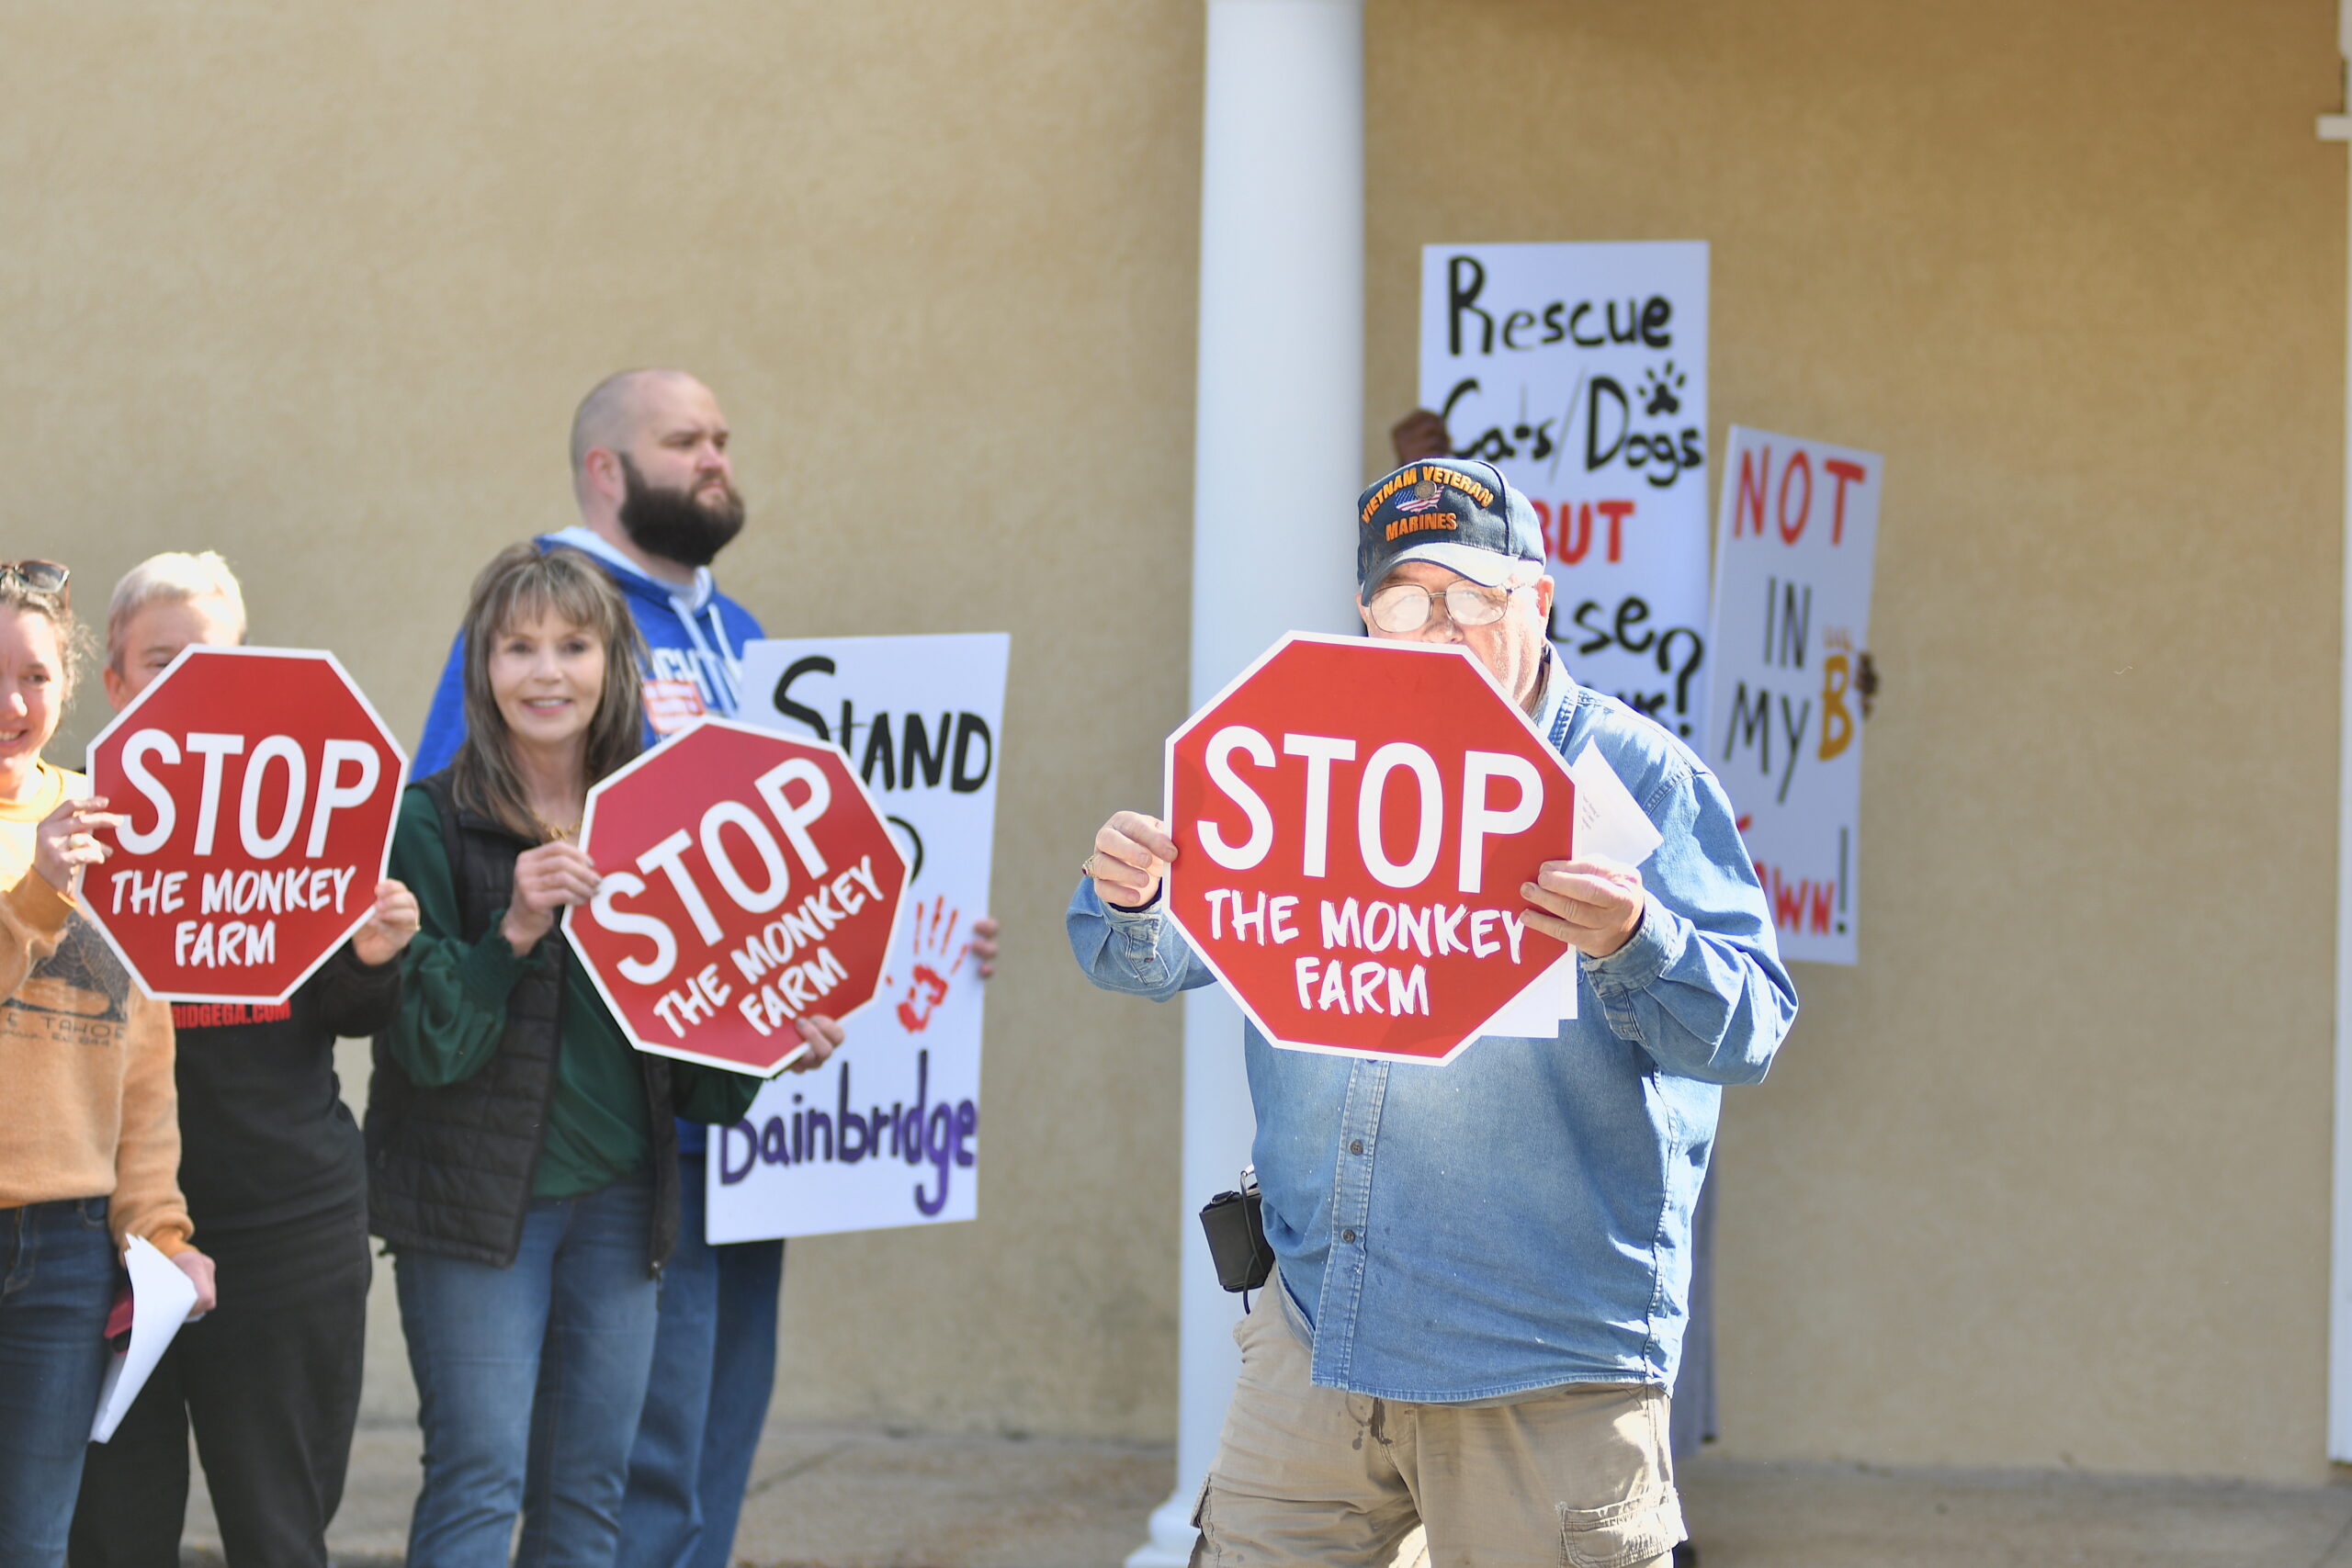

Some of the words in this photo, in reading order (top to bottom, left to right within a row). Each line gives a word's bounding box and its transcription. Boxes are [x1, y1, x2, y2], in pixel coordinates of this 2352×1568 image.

[1447, 255, 1673, 356] Rescue
[1362, 467, 1418, 525] VIETNAM
[1422, 466, 1495, 509] VETERAN
[1385, 512, 1458, 543] MARINES
[1733, 443, 1867, 547] NOT
[1764, 575, 1812, 671] IN
[1722, 676, 1810, 806] MY
[115, 728, 381, 860] STOP
[1196, 724, 1545, 895] STOP
[110, 867, 188, 917] THE
[200, 864, 357, 917] MONKEY
[590, 756, 833, 987] STOP
[174, 919, 277, 969] FARM
[652, 963, 731, 1038] THE
[729, 854, 886, 980] MONKEY
[1204, 888, 1299, 947] THE
[1319, 897, 1527, 965] MONKEY
[737, 947, 849, 1037] FARM
[1295, 955, 1430, 1017] FARM
